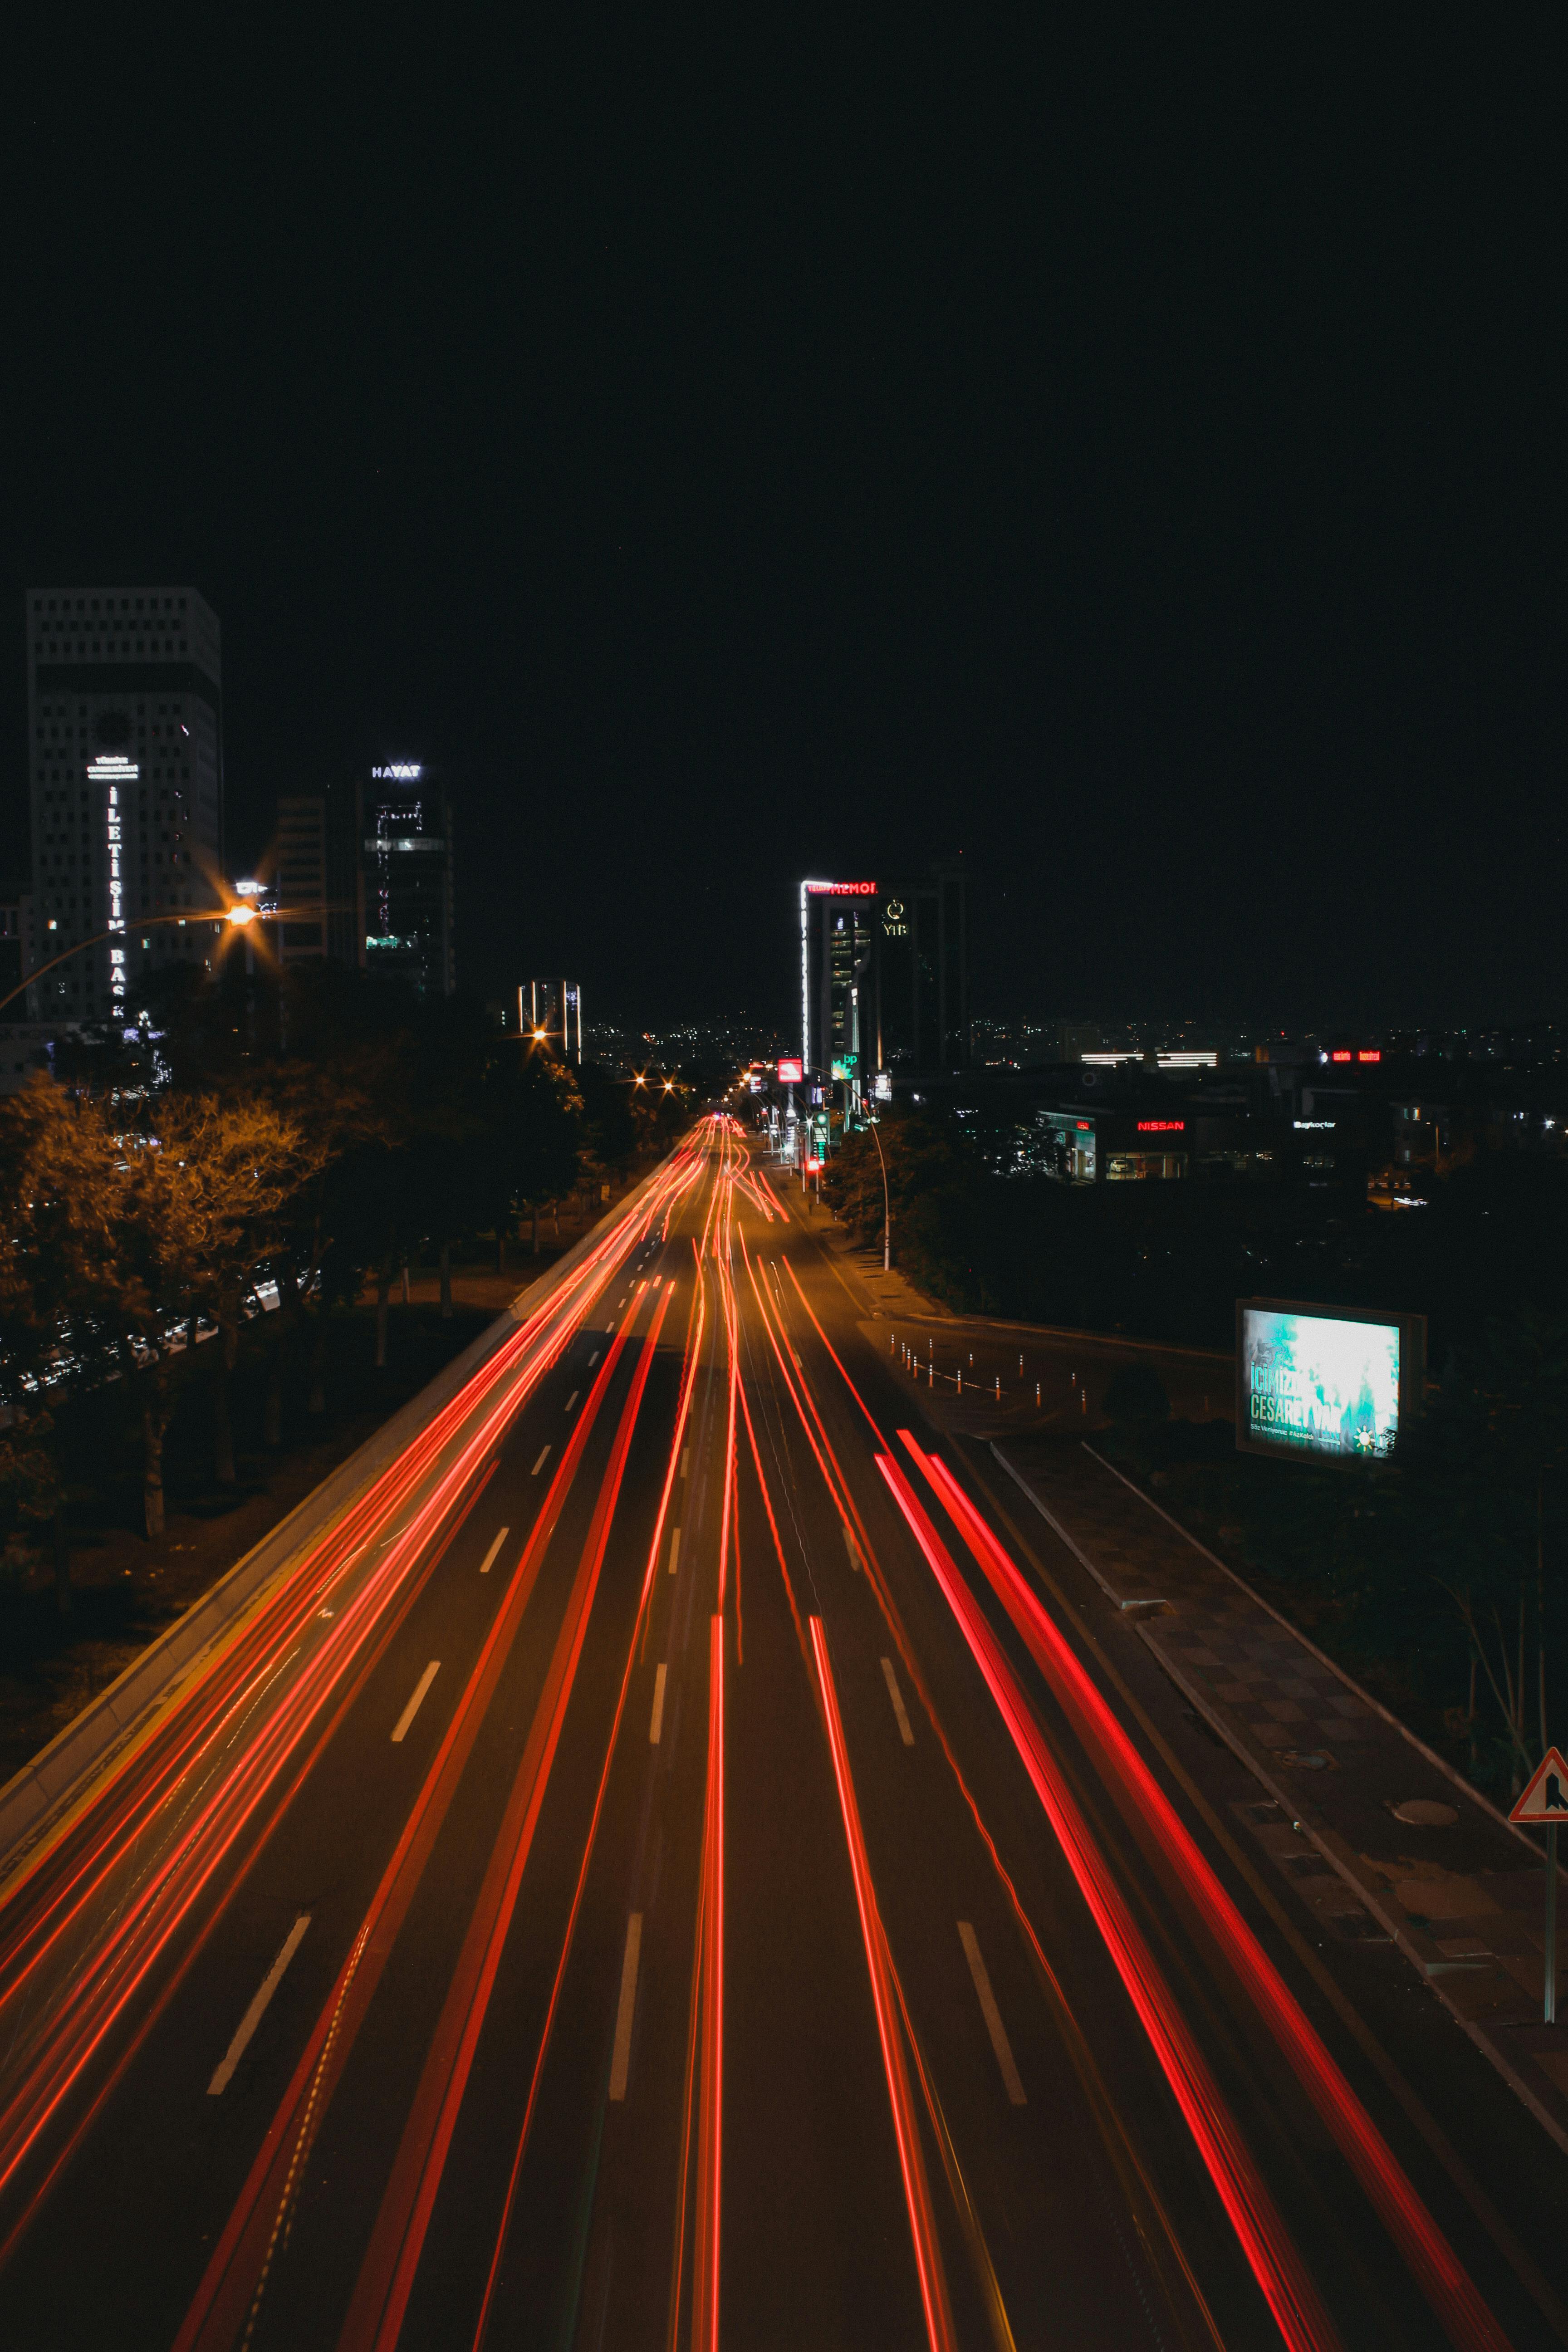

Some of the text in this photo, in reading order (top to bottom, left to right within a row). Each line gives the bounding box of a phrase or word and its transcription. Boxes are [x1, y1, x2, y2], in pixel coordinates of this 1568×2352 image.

[372, 765, 421, 778] HAYAT
[843, 1054, 858, 1065] bp
[1137, 1121, 1185, 1131] NISSAN
[1251, 1394, 1310, 1428] CESARET
